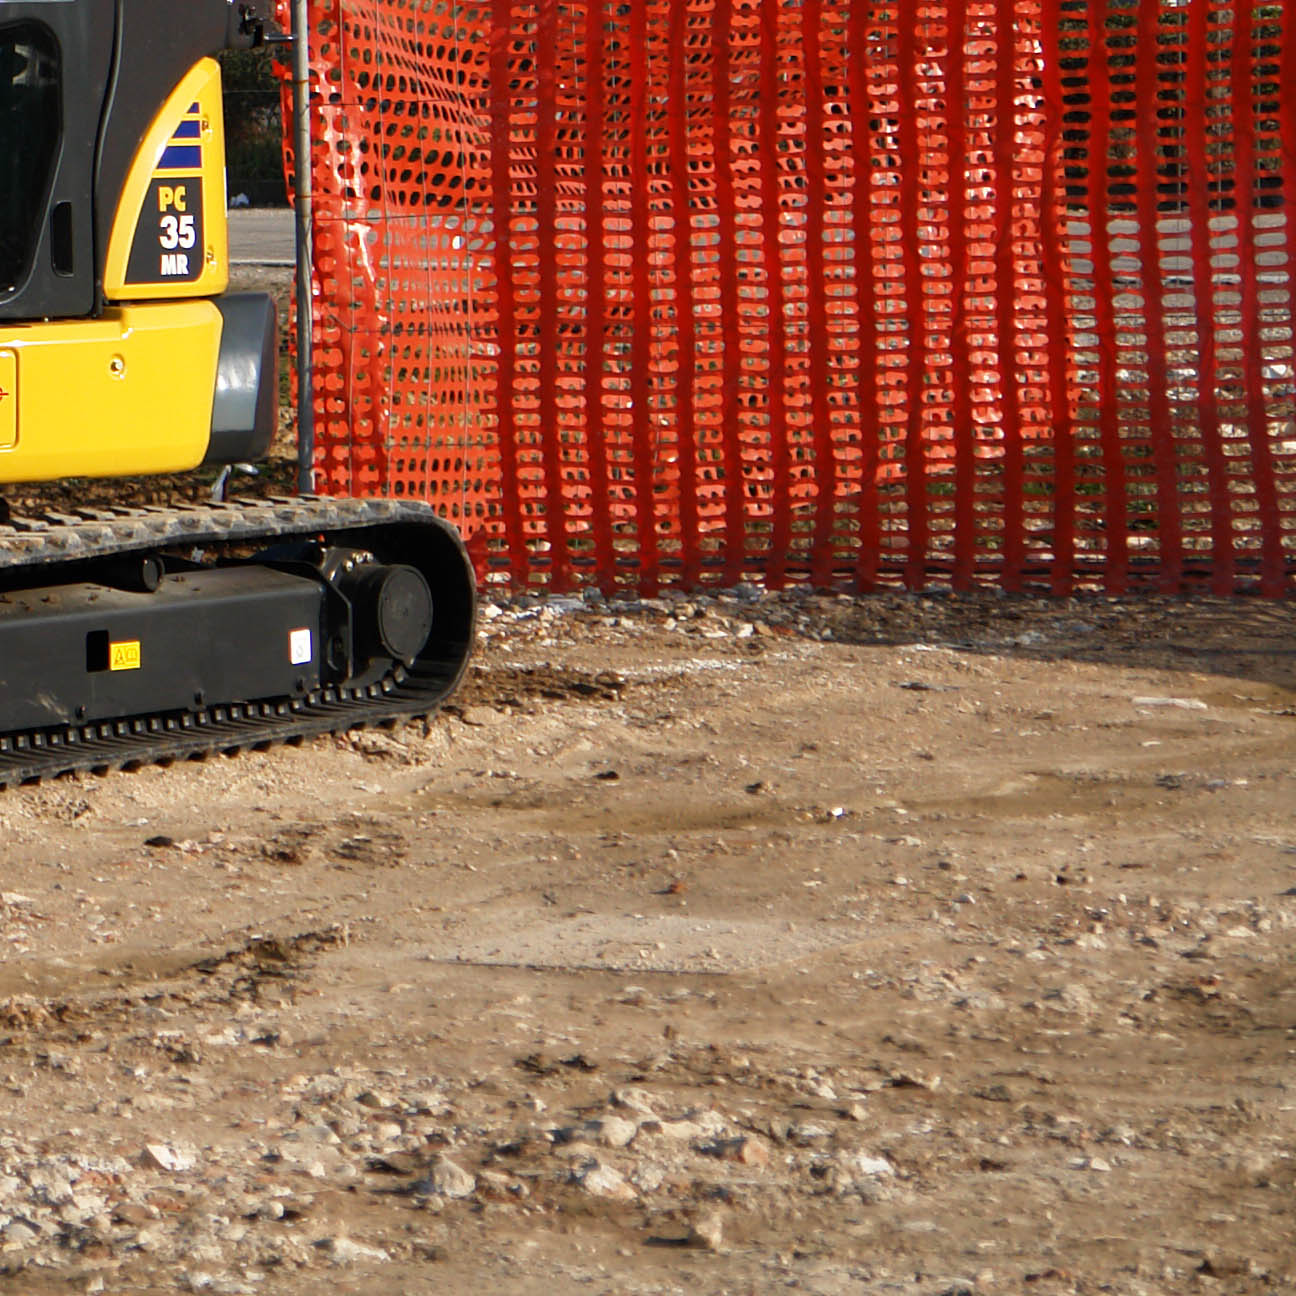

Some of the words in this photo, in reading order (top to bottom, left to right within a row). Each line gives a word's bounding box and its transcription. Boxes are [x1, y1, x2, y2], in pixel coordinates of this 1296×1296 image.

[158, 186, 186, 212] PC
[159, 215, 196, 250] 35
[160, 254, 189, 276] MR
